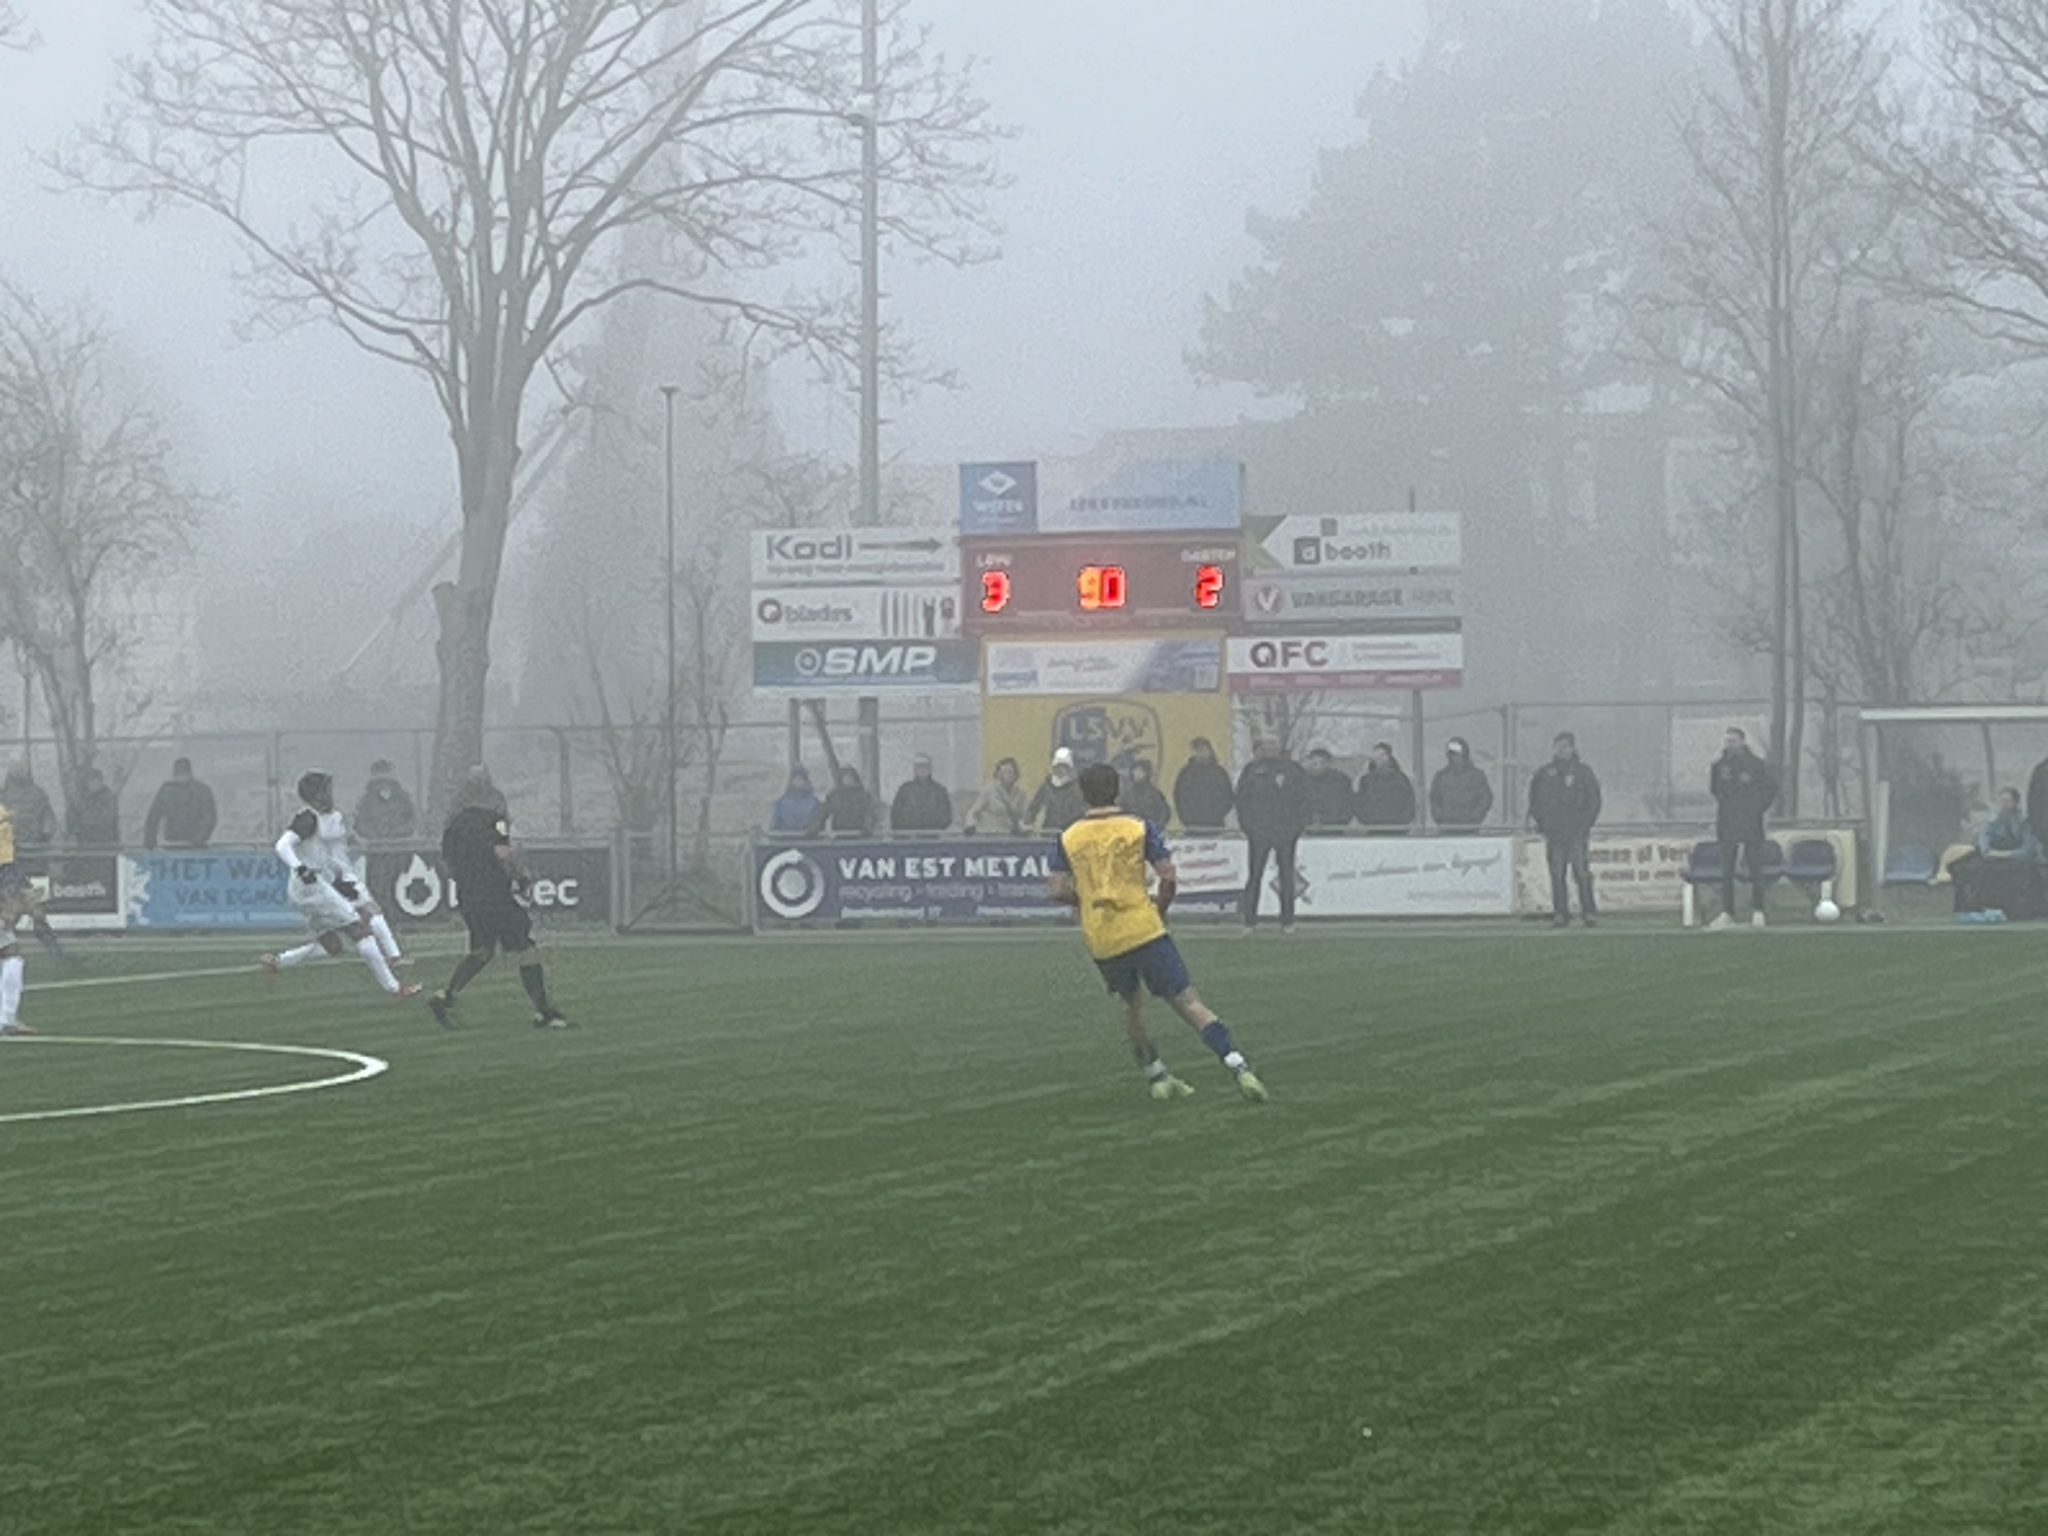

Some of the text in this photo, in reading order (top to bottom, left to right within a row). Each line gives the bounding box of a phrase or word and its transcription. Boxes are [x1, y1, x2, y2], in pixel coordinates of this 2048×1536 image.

[981, 571, 1010, 613] 3
[1196, 566, 1224, 609] 2
[822, 646, 937, 675] SMP
[1249, 641, 1330, 668] QFC
[838, 857, 896, 880] VAN
[905, 857, 956, 878] EST
